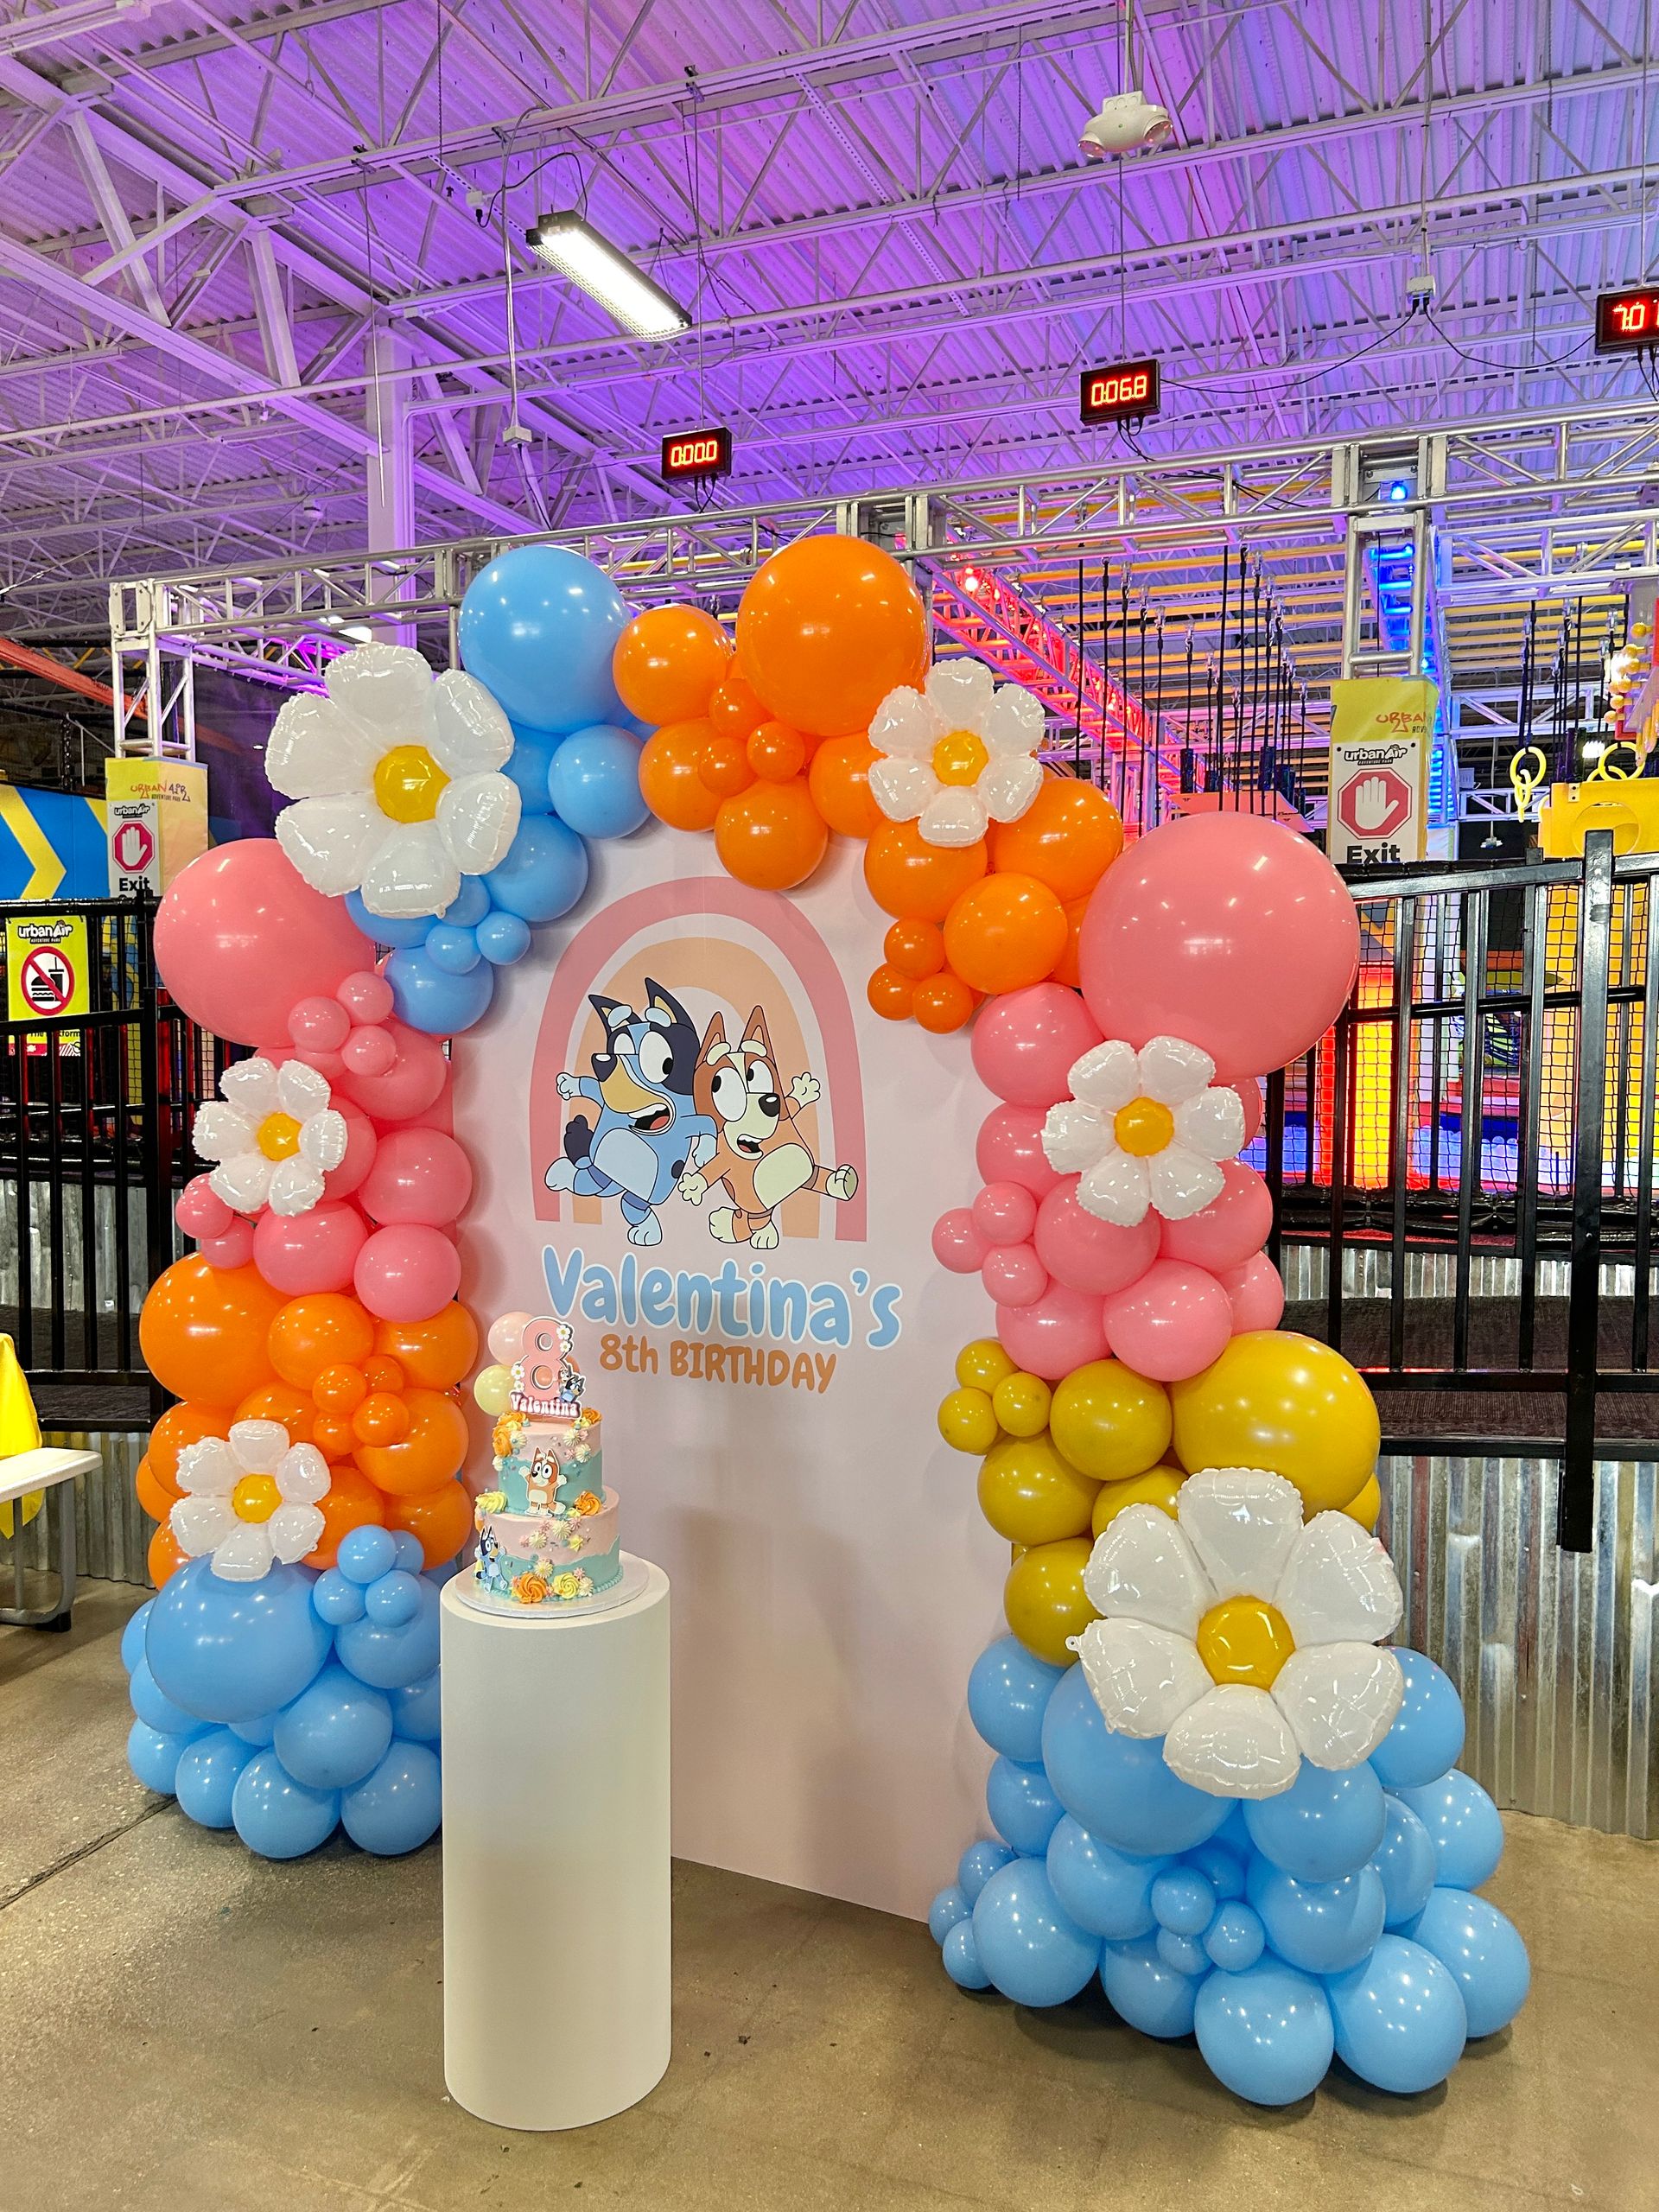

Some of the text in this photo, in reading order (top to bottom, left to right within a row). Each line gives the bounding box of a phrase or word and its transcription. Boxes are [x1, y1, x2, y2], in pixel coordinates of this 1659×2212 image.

[1346, 842, 1401, 864] Exit
[119, 875, 150, 891] Exit
[542, 1244, 904, 1350] Valentina's
[518, 1317, 569, 1398] 8
[600, 1333, 837, 1395] 8th BIRTHDAY
[511, 1393, 578, 1417] Valentina
